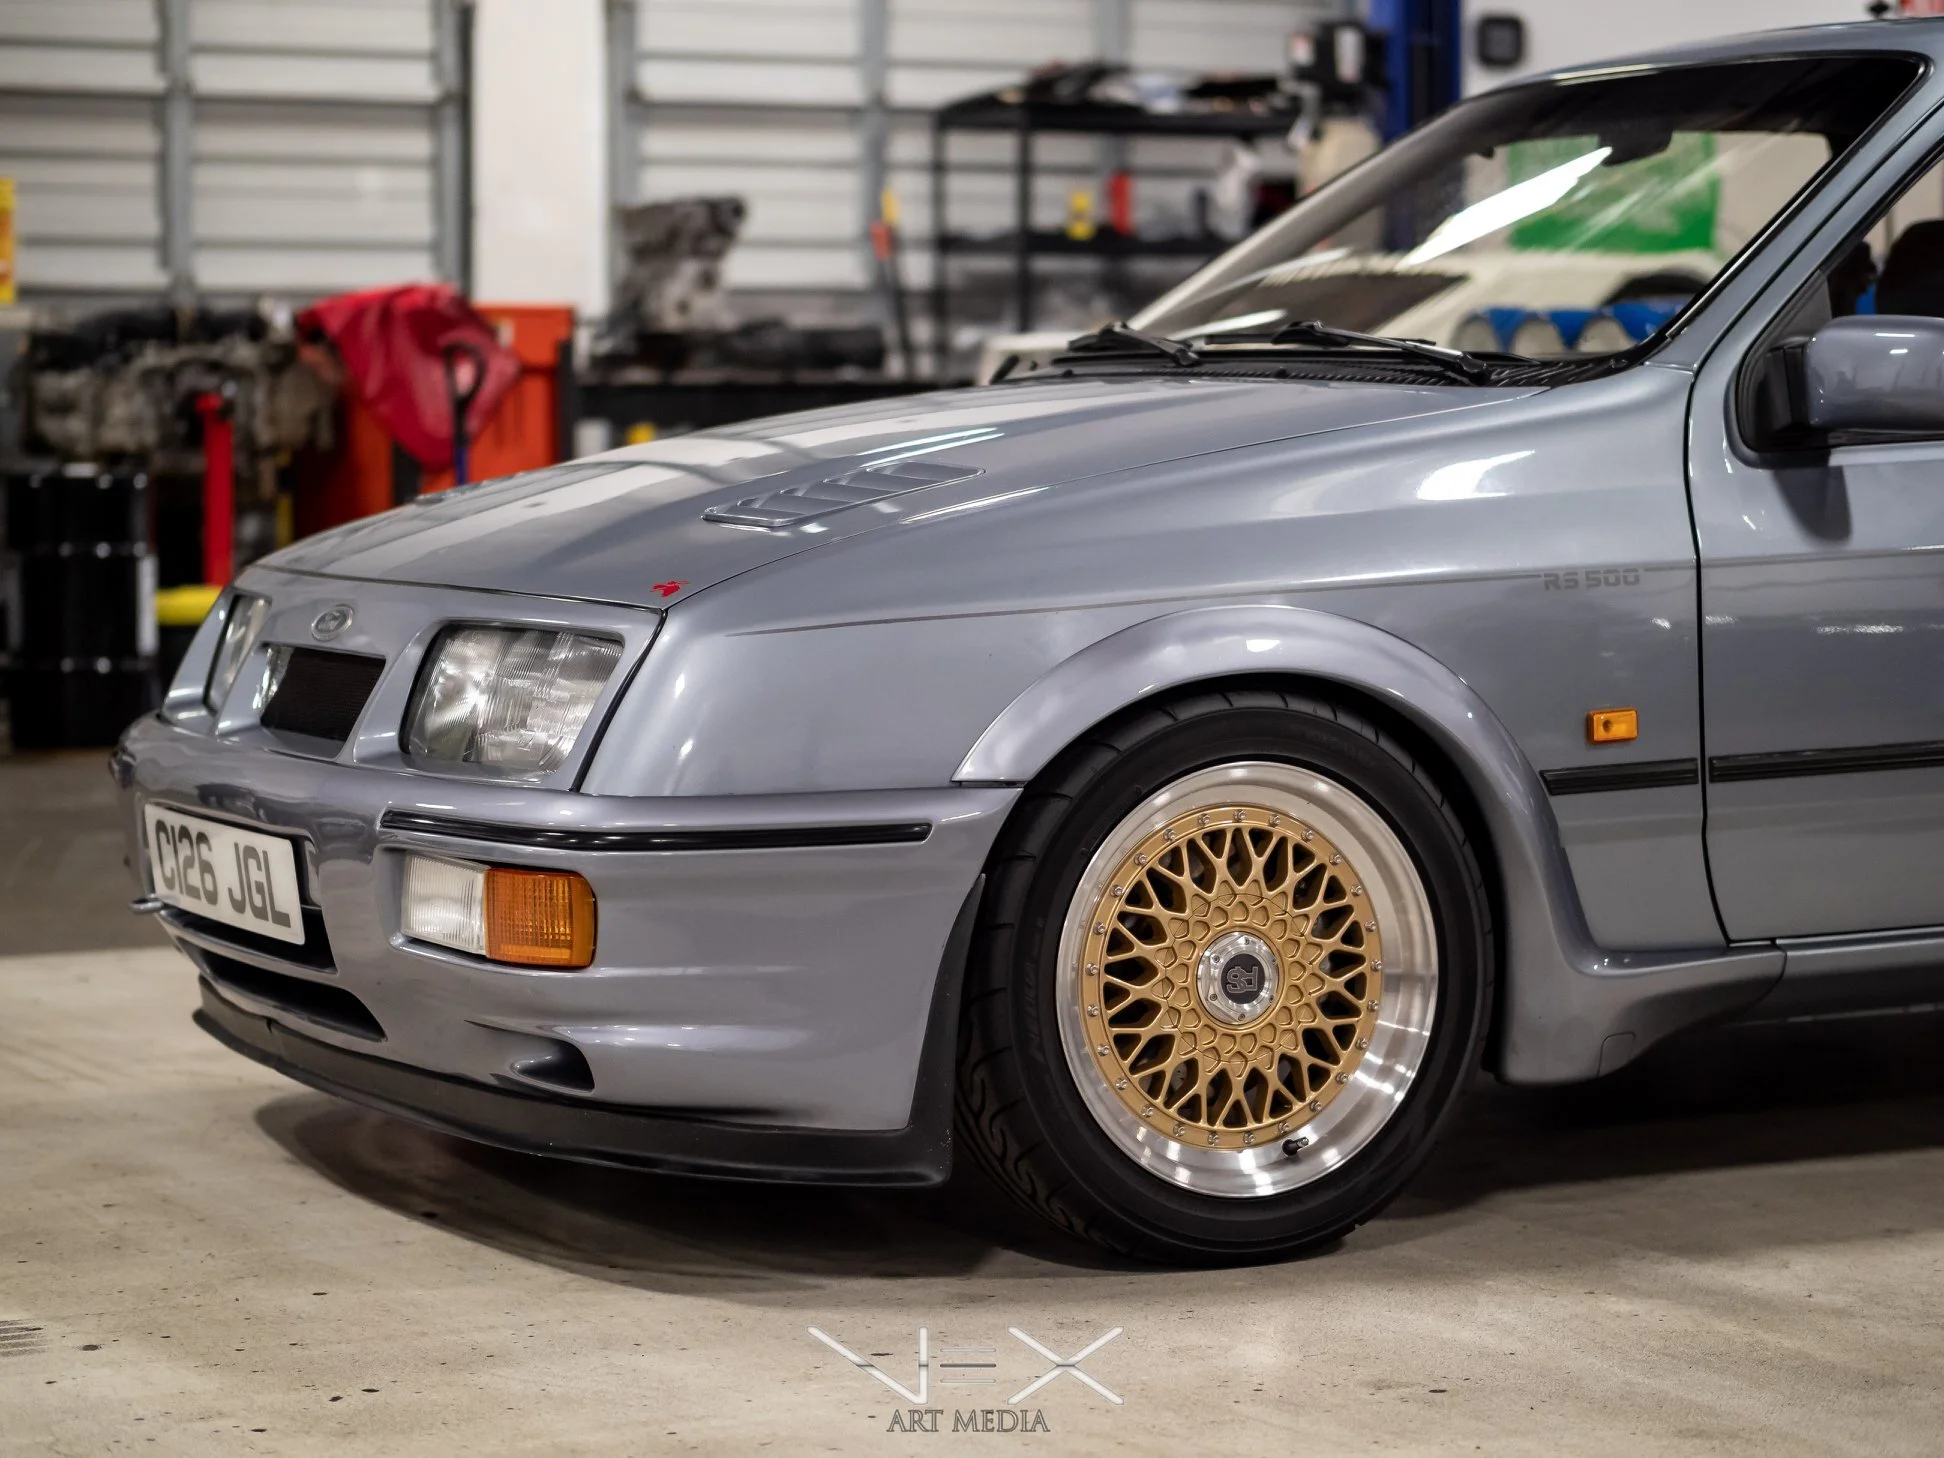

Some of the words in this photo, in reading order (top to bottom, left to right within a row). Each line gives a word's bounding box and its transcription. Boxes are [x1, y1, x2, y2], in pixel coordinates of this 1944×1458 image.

[1543, 571, 1579, 591] RS
[1585, 567, 1640, 589] 500
[155, 819, 218, 906] C126
[227, 841, 291, 929] JGL
